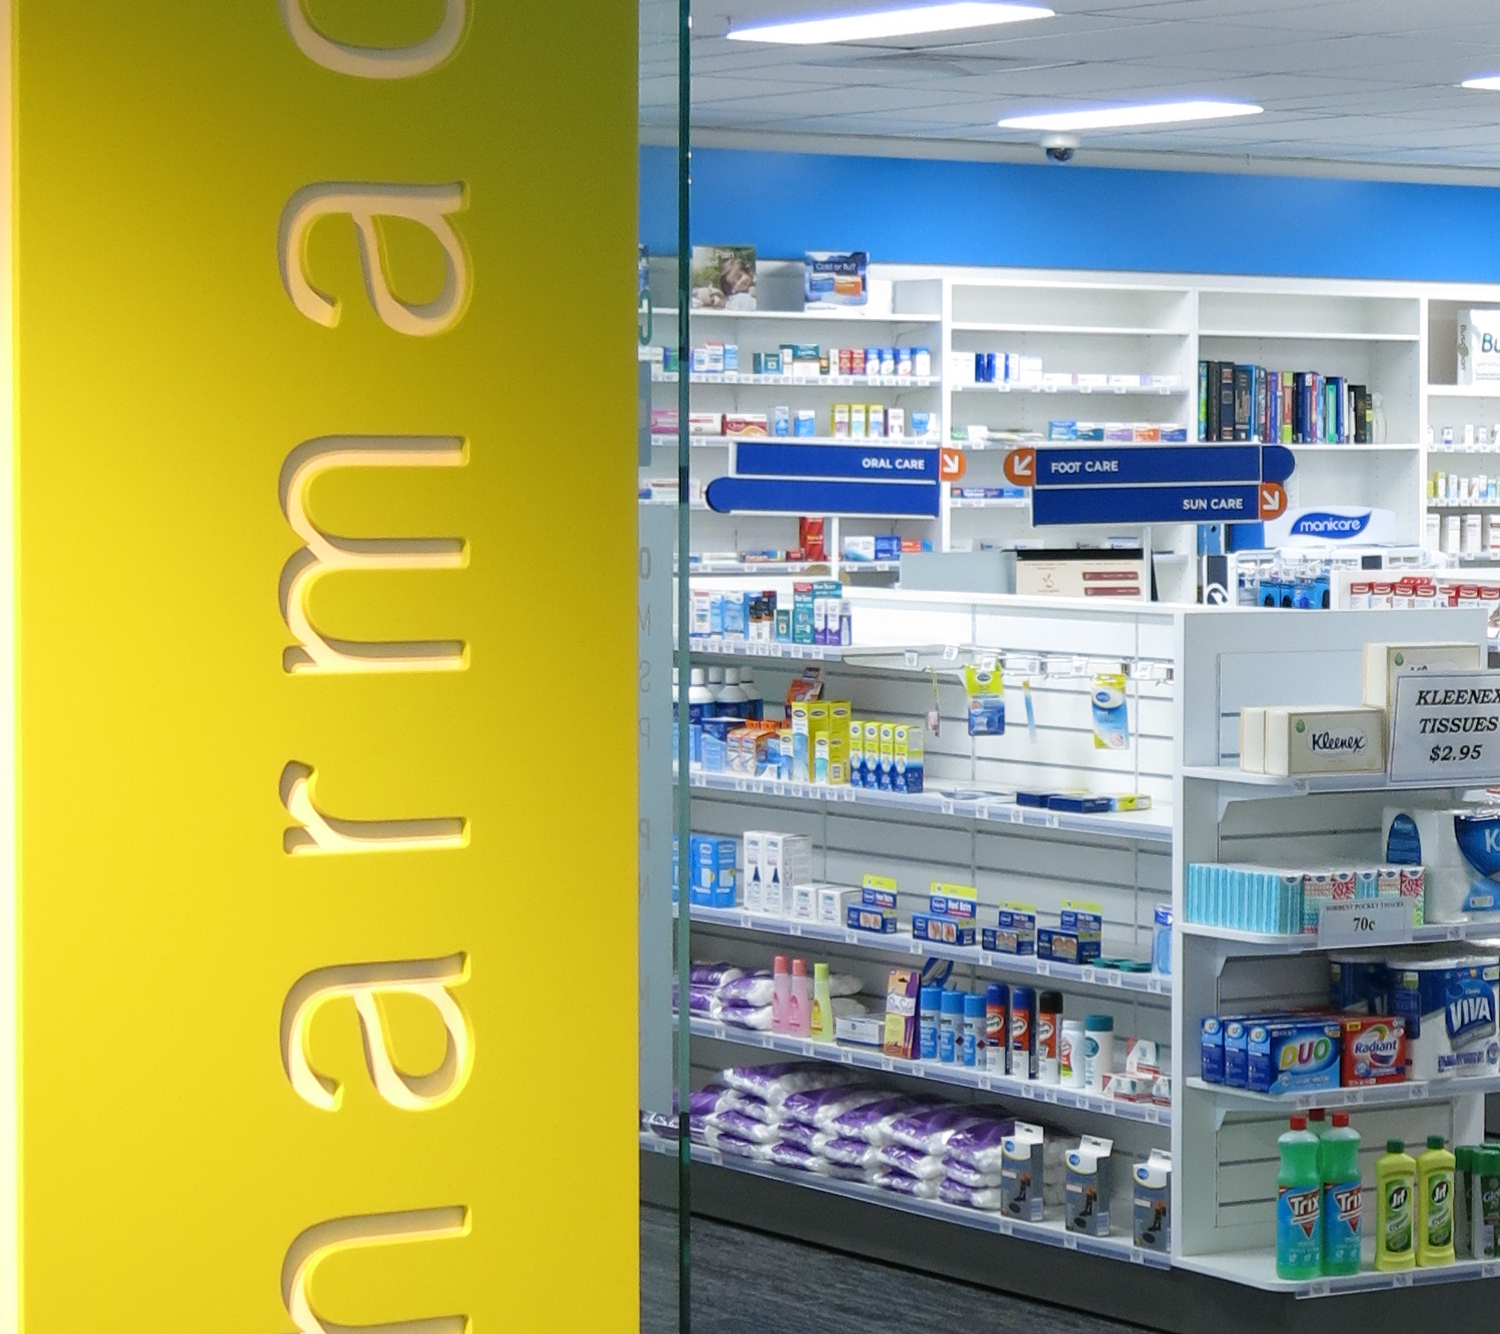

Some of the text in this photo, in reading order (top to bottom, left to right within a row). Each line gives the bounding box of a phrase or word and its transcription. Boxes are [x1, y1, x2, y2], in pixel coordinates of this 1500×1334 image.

[862, 457, 925, 470] ORAL CARE
[1051, 461, 1119, 474] FOOT CARE
[1183, 498, 1243, 511] SUN CARE
[1300, 516, 1362, 532] manicare
[1419, 716, 1498, 735] TISSUES
[1312, 730, 1366, 752] Kleenex
[1429, 744, 1482, 763] $2.95
[1352, 916, 1376, 932] 70c
[1449, 997, 1491, 1031] VIVA
[1280, 1037, 1332, 1071] DUO
[1354, 1040, 1398, 1055] Radiant
